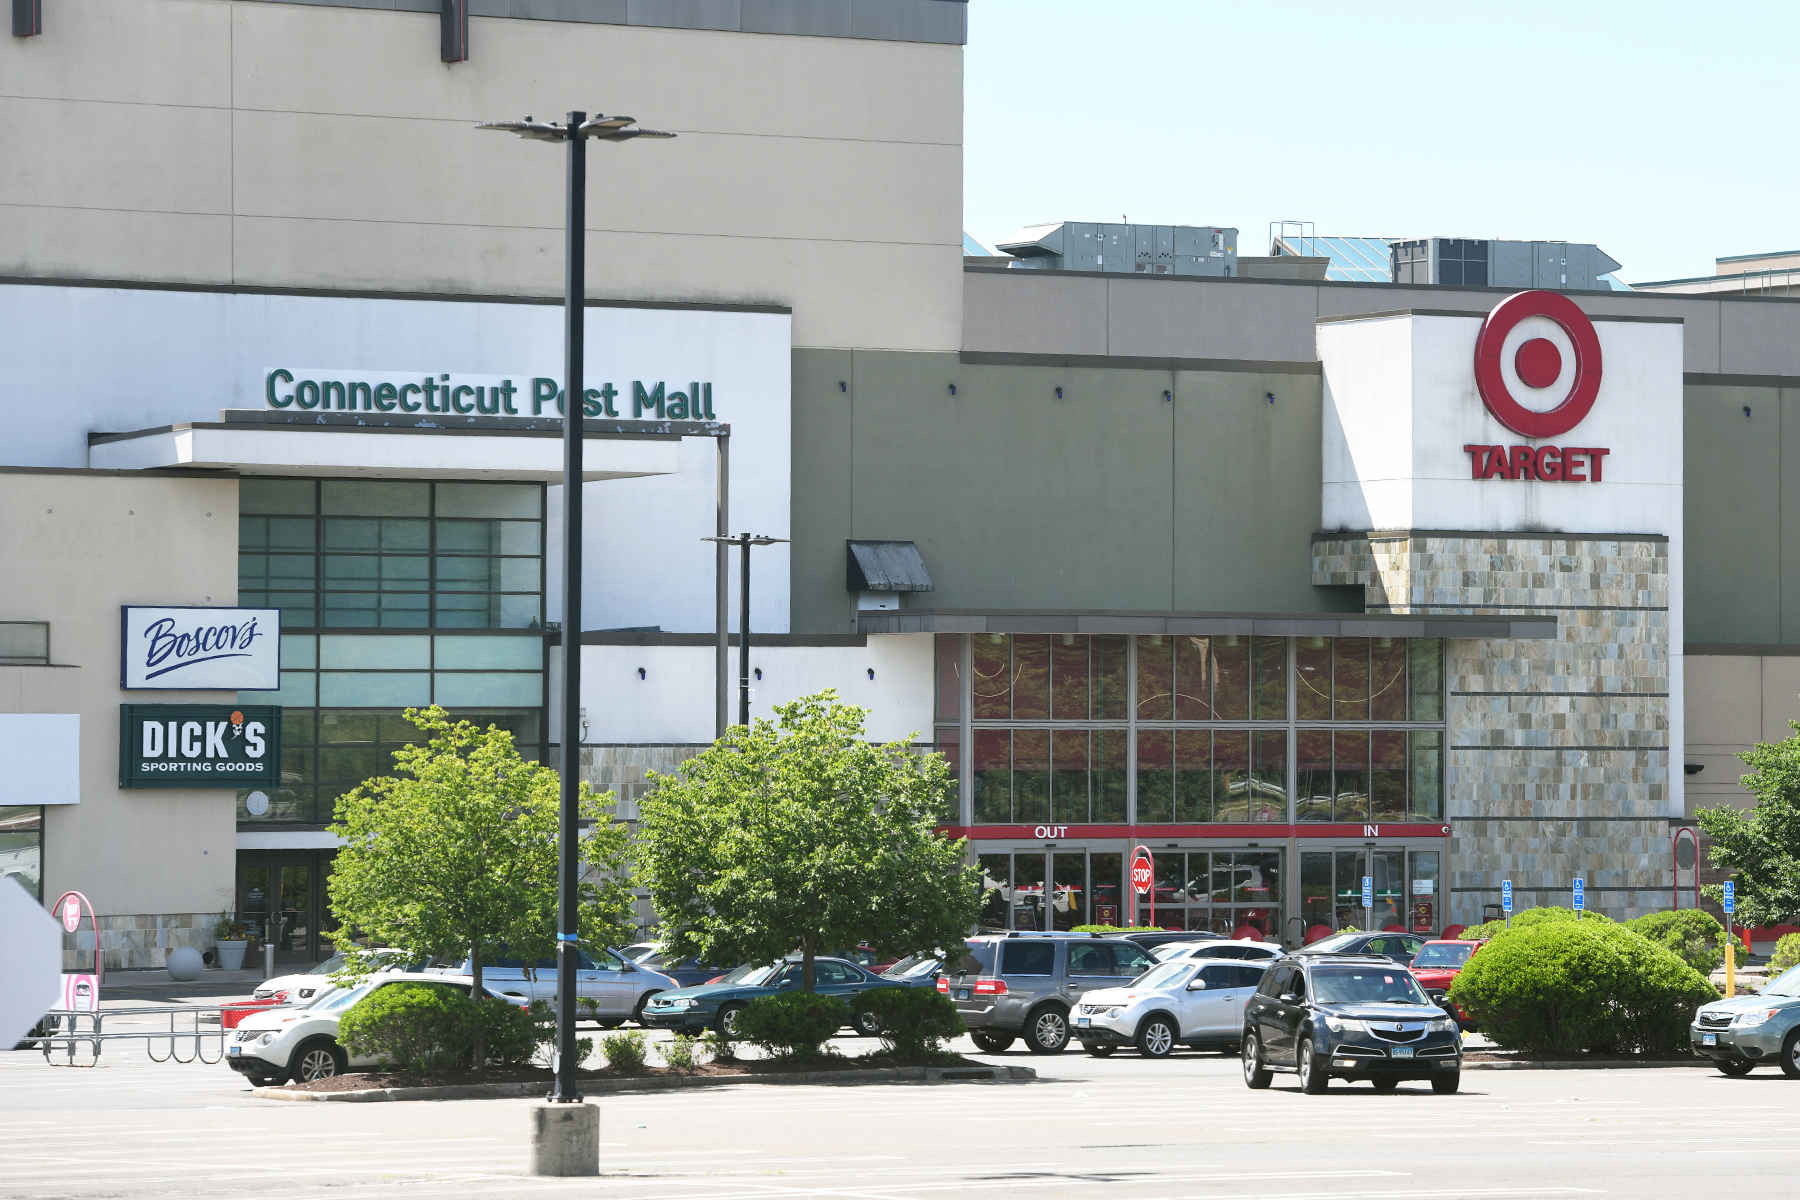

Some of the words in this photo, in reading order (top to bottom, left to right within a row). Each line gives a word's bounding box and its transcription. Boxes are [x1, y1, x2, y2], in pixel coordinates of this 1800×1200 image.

[267, 368, 518, 415] Connecticut
[633, 380, 716, 420] Mall
[1463, 444, 1611, 482] TARGET
[144, 616, 263, 668] Boscov's
[142, 712, 266, 758] DICK'S
[141, 762, 212, 772] SPORTING
[216, 762, 264, 772] GOODS
[1035, 825, 1068, 839] OUT
[1363, 824, 1379, 838] IN
[1134, 869, 1151, 882] STOP
